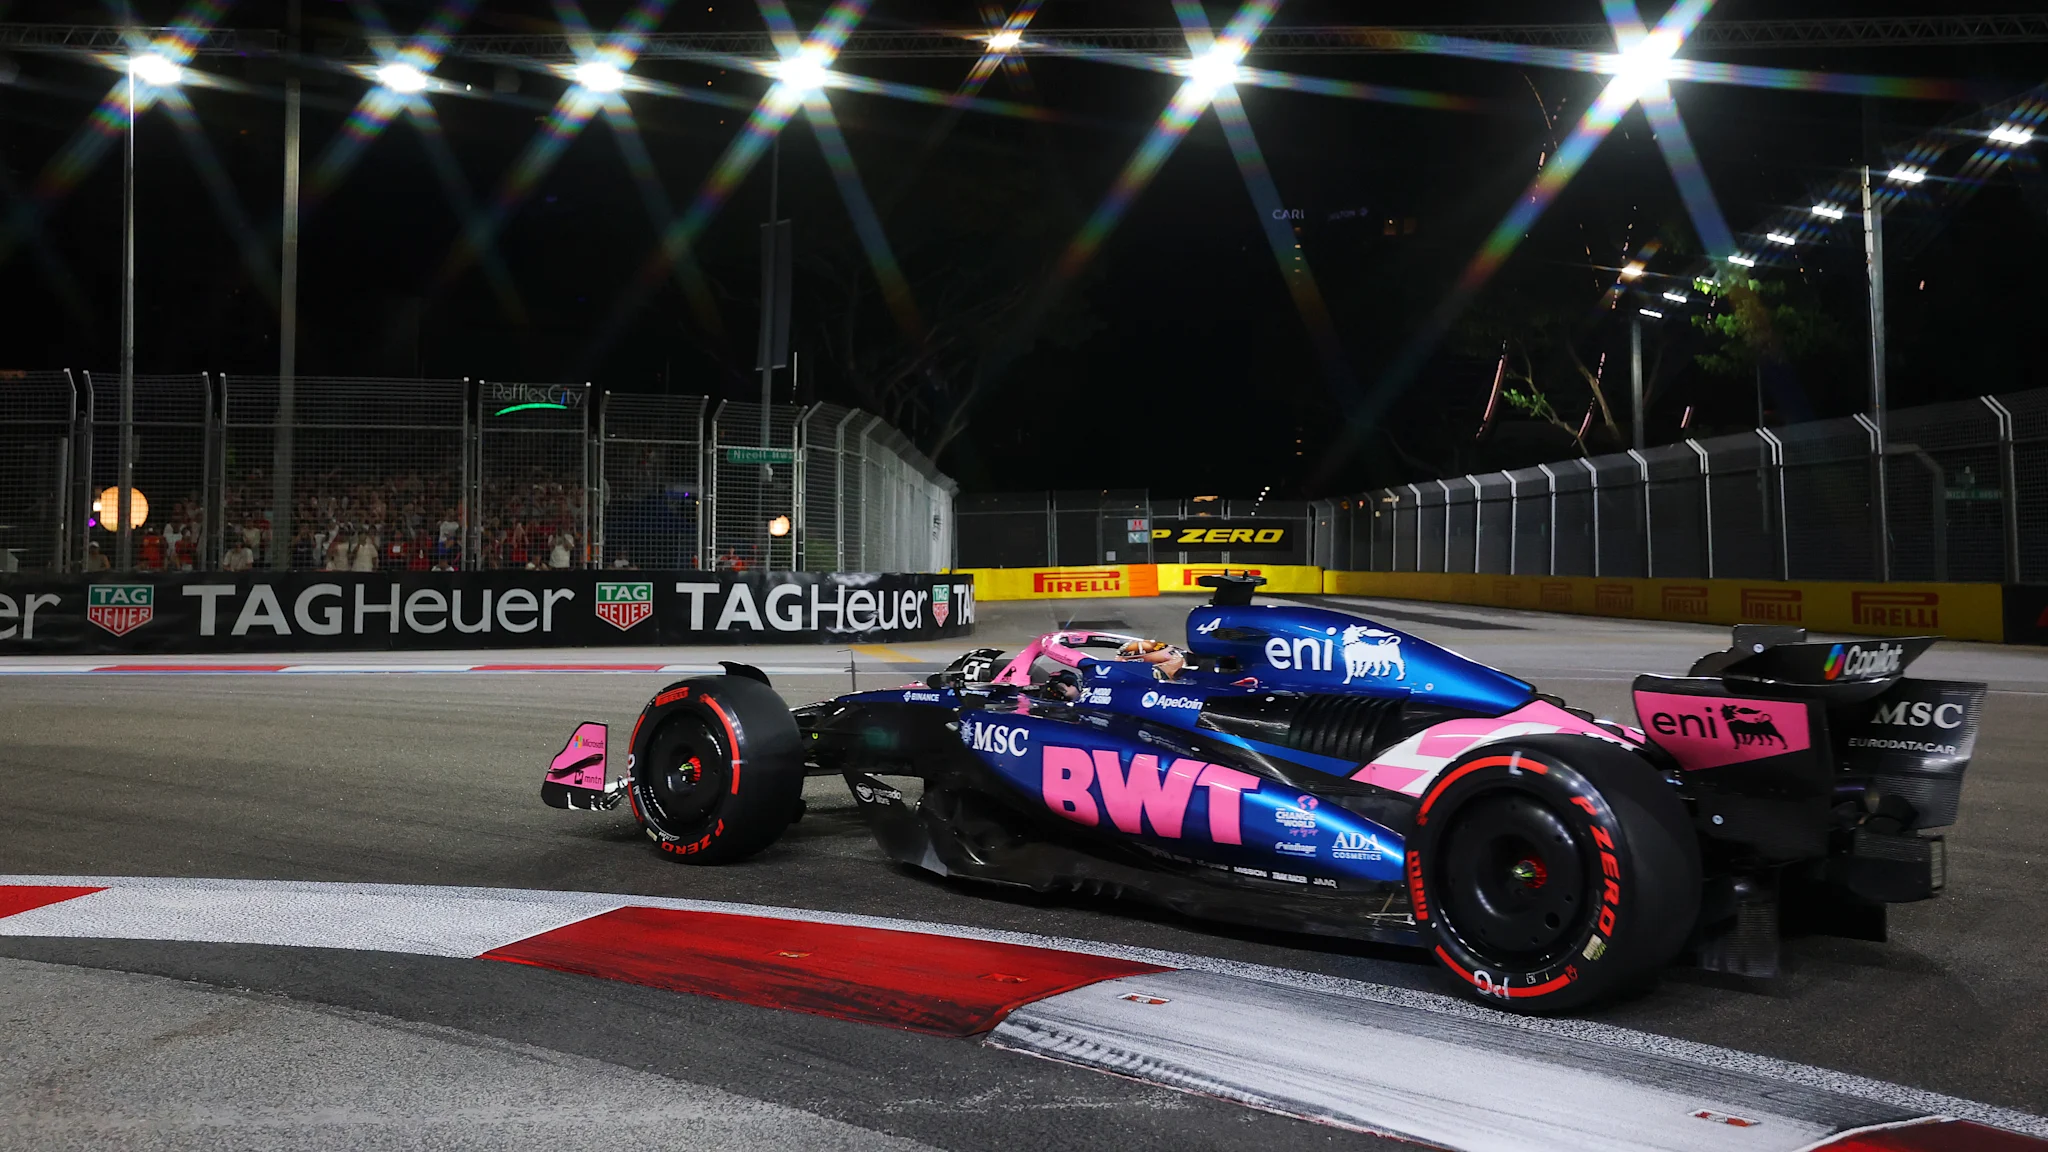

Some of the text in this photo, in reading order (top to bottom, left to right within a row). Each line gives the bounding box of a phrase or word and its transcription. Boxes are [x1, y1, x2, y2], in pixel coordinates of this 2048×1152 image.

[1177, 528, 1284, 543] ZERO
[600, 585, 648, 600] TAG
[1034, 571, 1120, 593] PIRELLI
[95, 588, 148, 603] TAG
[1741, 588, 1802, 622] PIRELLI
[91, 607, 150, 633] HEUER
[598, 602, 651, 628] HEUER
[1852, 590, 1938, 628] PIRELLI
[1265, 626, 1336, 671] eni
[1844, 642, 1903, 677] Copilot
[911, 692, 940, 703] BINANCE
[1157, 694, 1203, 711] ApeCoin
[1652, 707, 1717, 740] eni
[1870, 701, 1963, 729] MSC
[583, 738, 604, 749] Microsoft
[973, 721, 1029, 757] MSC
[1848, 737, 1957, 756] EURODATACAR
[584, 774, 602, 785] mntn
[1042, 745, 1261, 845] BWT
[1275, 811, 1316, 821] CHANGE
[662, 833, 711, 855] ZERO
[1332, 832, 1382, 850] ADA
[1333, 852, 1382, 861] COSMETICS
[1589, 824, 1621, 938] ZERO
